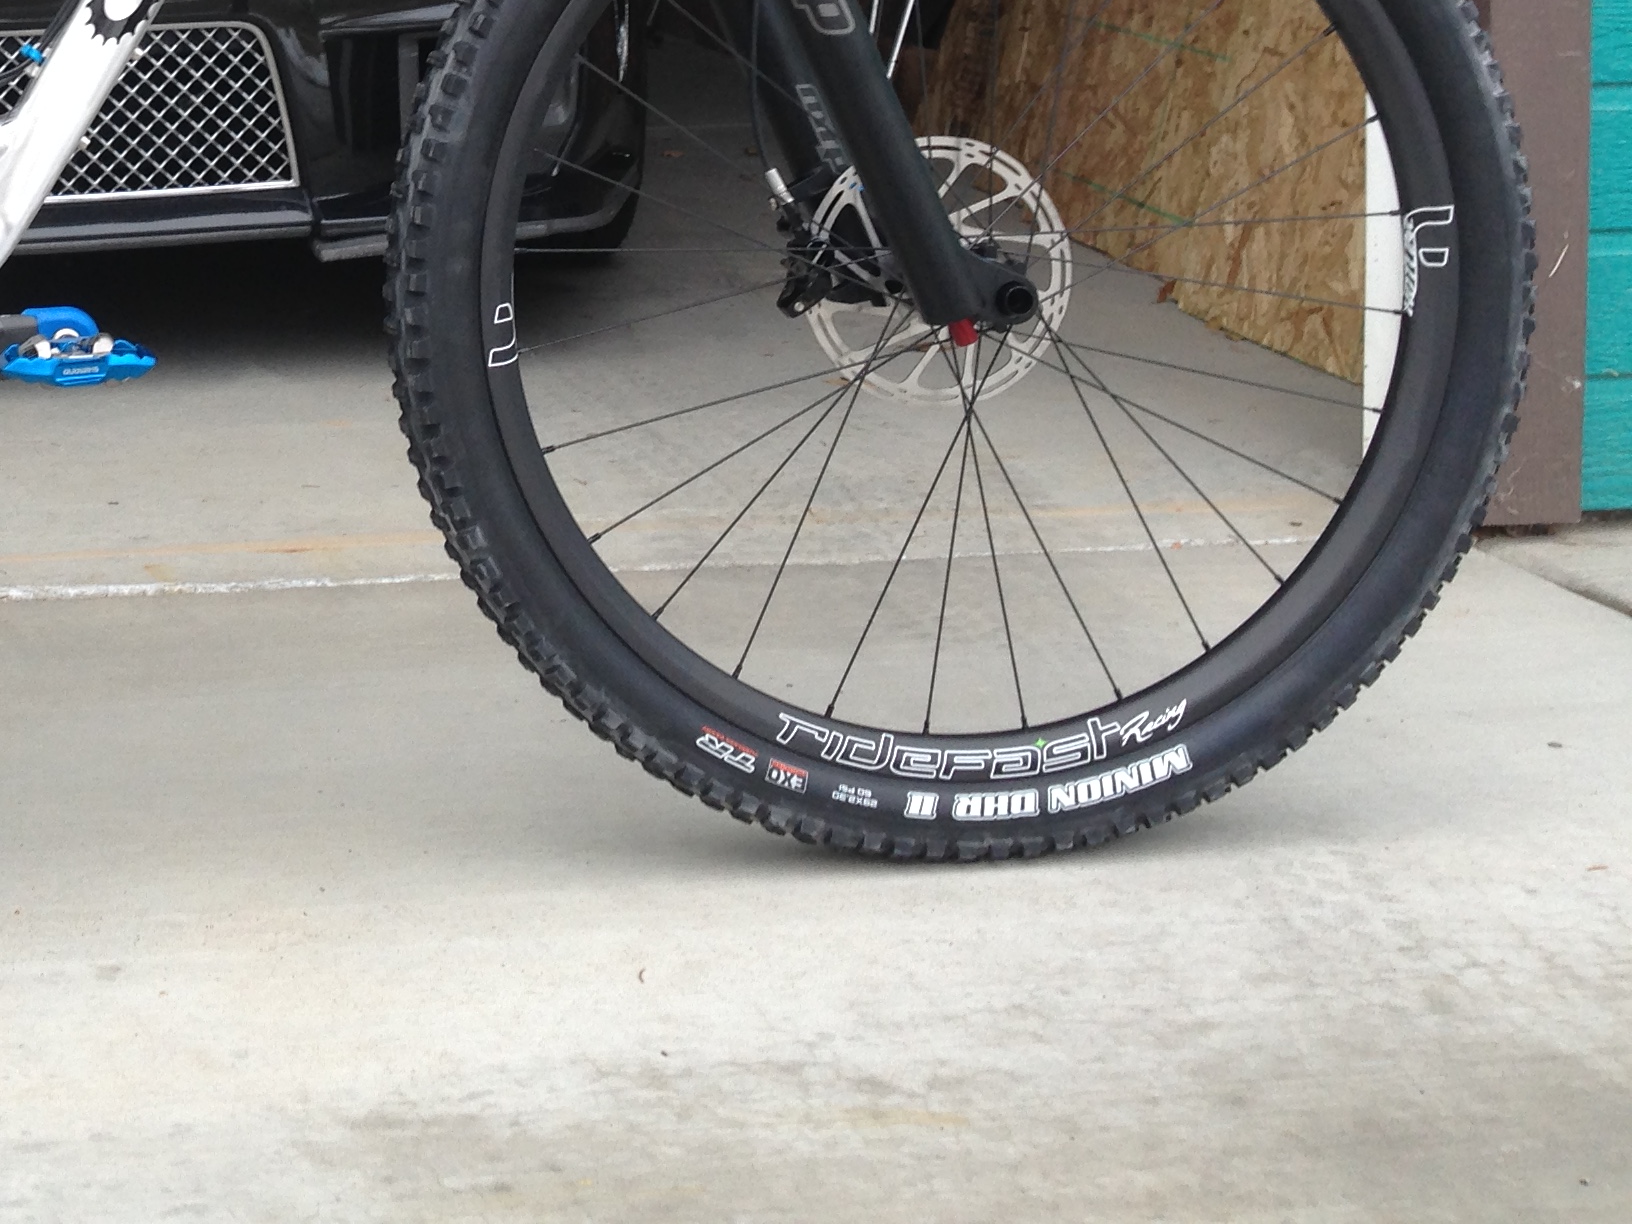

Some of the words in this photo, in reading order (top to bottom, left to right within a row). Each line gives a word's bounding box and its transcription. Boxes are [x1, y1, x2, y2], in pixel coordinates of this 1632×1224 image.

[1120, 699, 1187, 748] Racing
[695, 733, 756, 774] TR
[1047, 744, 1193, 813] MINION
[951, 790, 1041, 821] DHR
